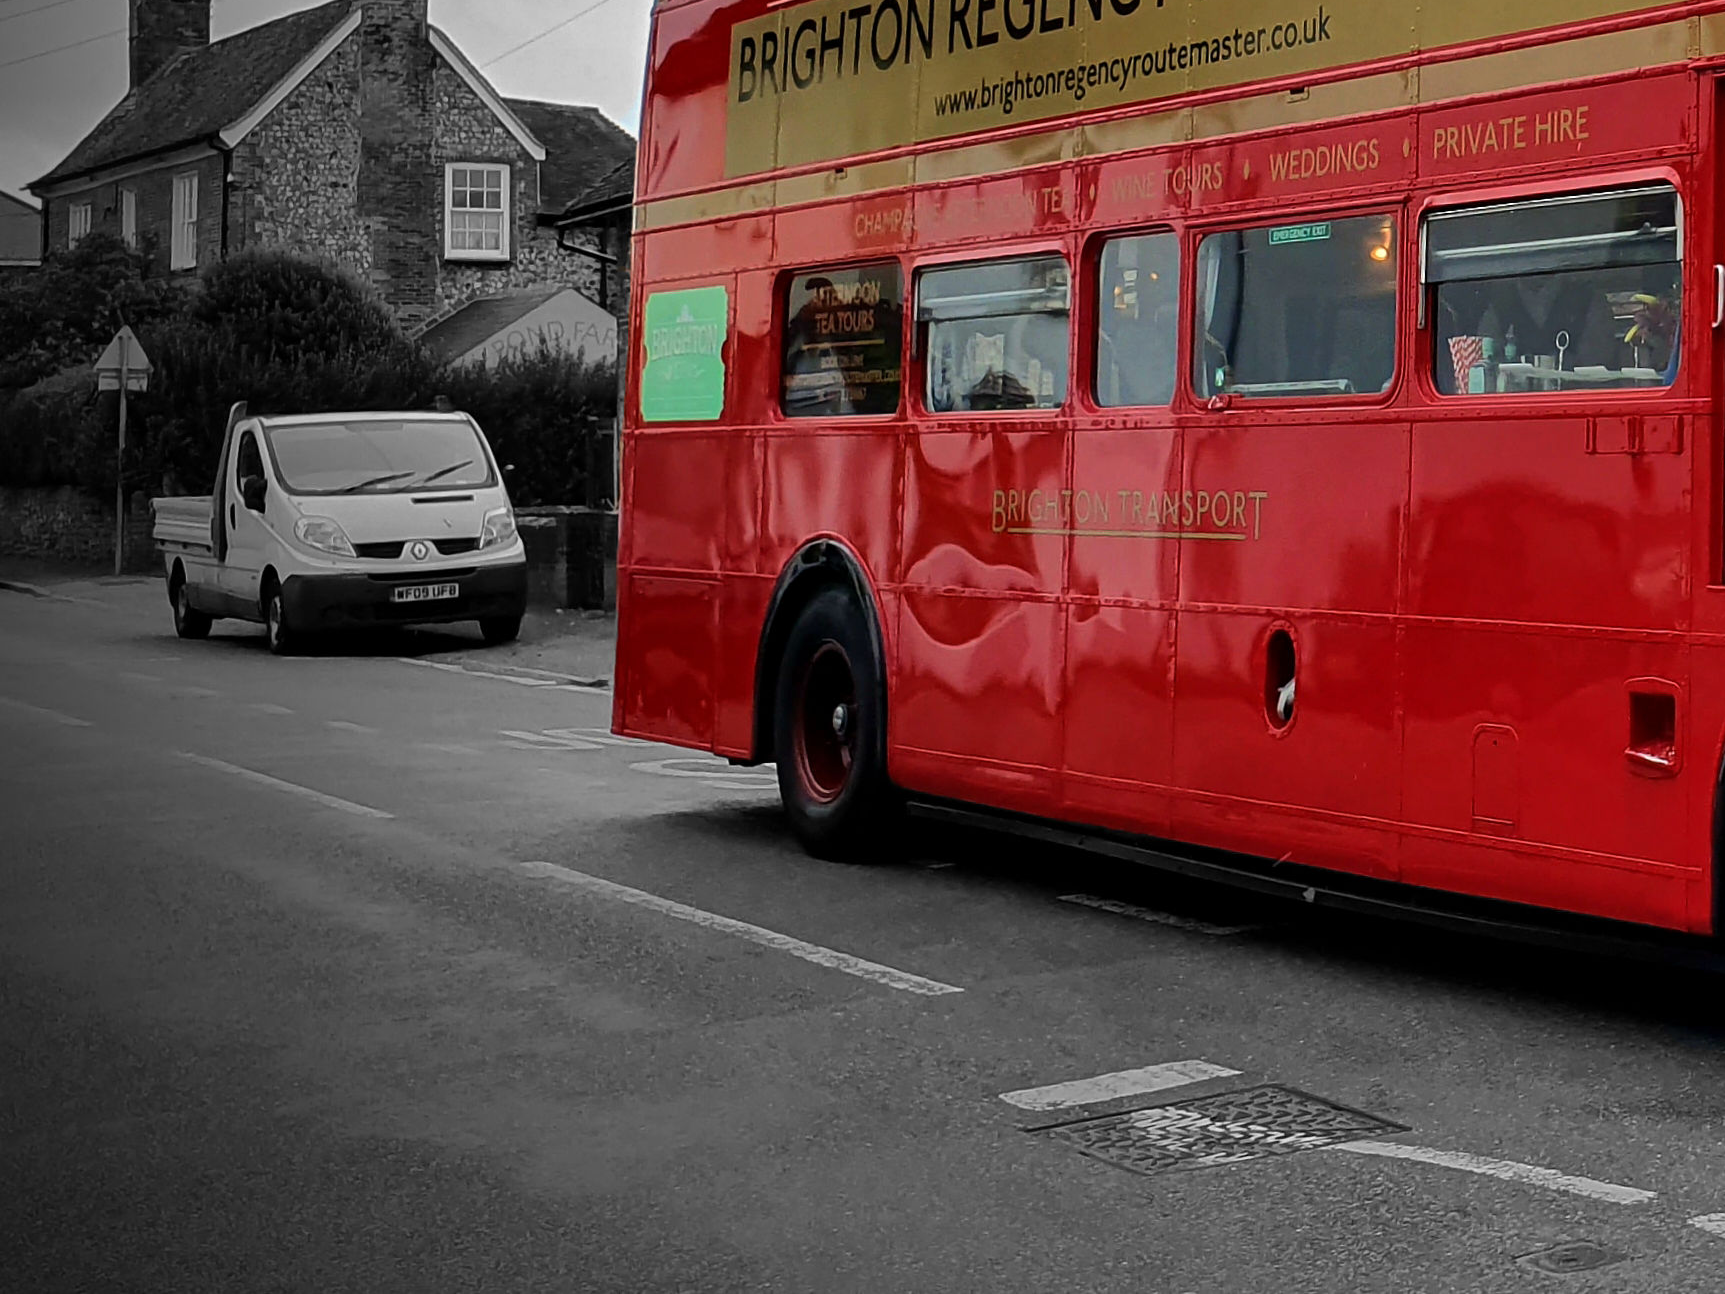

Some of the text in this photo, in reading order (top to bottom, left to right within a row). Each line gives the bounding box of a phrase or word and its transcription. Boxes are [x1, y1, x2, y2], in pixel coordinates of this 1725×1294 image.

[935, 7, 1331, 116] www.brightonregencyroutemaster.co.uk
[1163, 162, 1224, 195] TOURS
[1270, 138, 1380, 182] WEDDINGS
[1433, 116, 1527, 160] PRIVATE
[1535, 106, 1589, 146] HIRE
[815, 309, 875, 334] TEA TOURS
[991, 489, 1268, 541] BRIGHTON TRANSPORT
